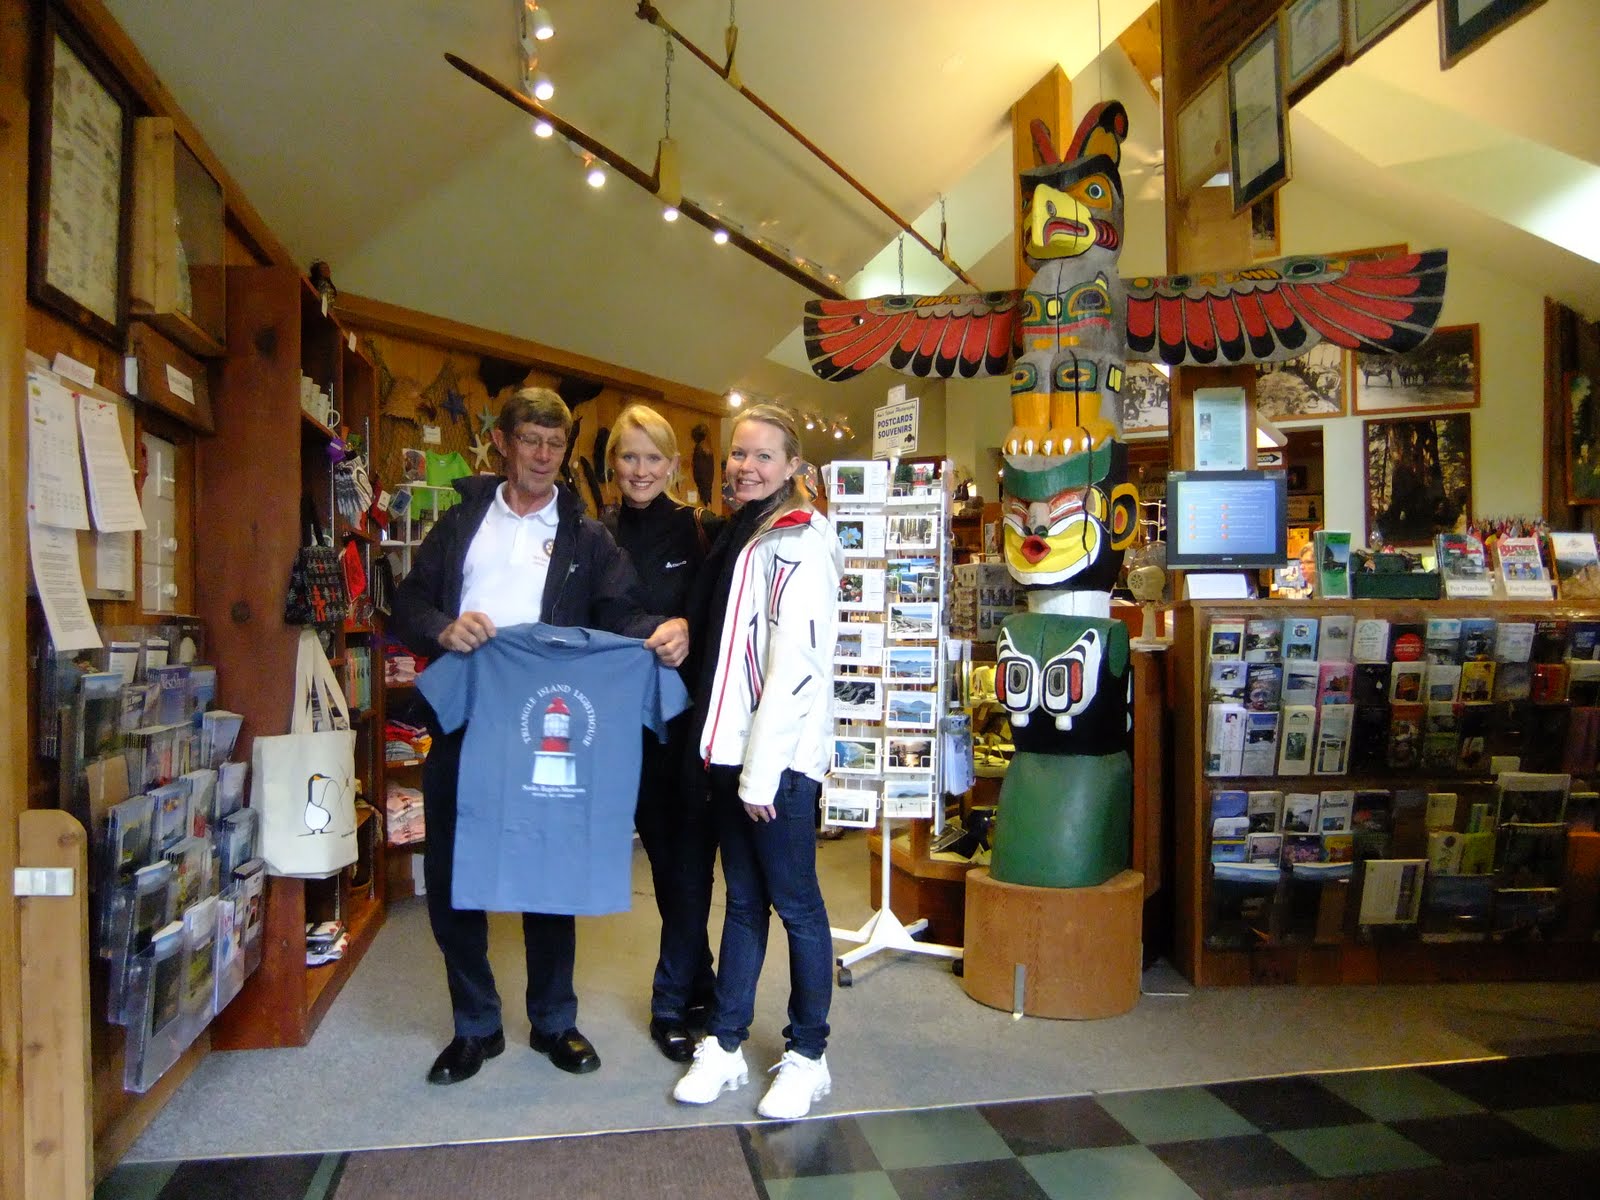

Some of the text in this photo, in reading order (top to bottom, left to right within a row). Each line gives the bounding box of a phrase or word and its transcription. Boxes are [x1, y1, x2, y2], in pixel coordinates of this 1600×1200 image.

[878, 414, 913, 429] POSTCARDS
[878, 424, 912, 439] SOUVENIRS
[521, 684, 597, 747] TRIANGLE ISLAND LIGHTHOUSE
